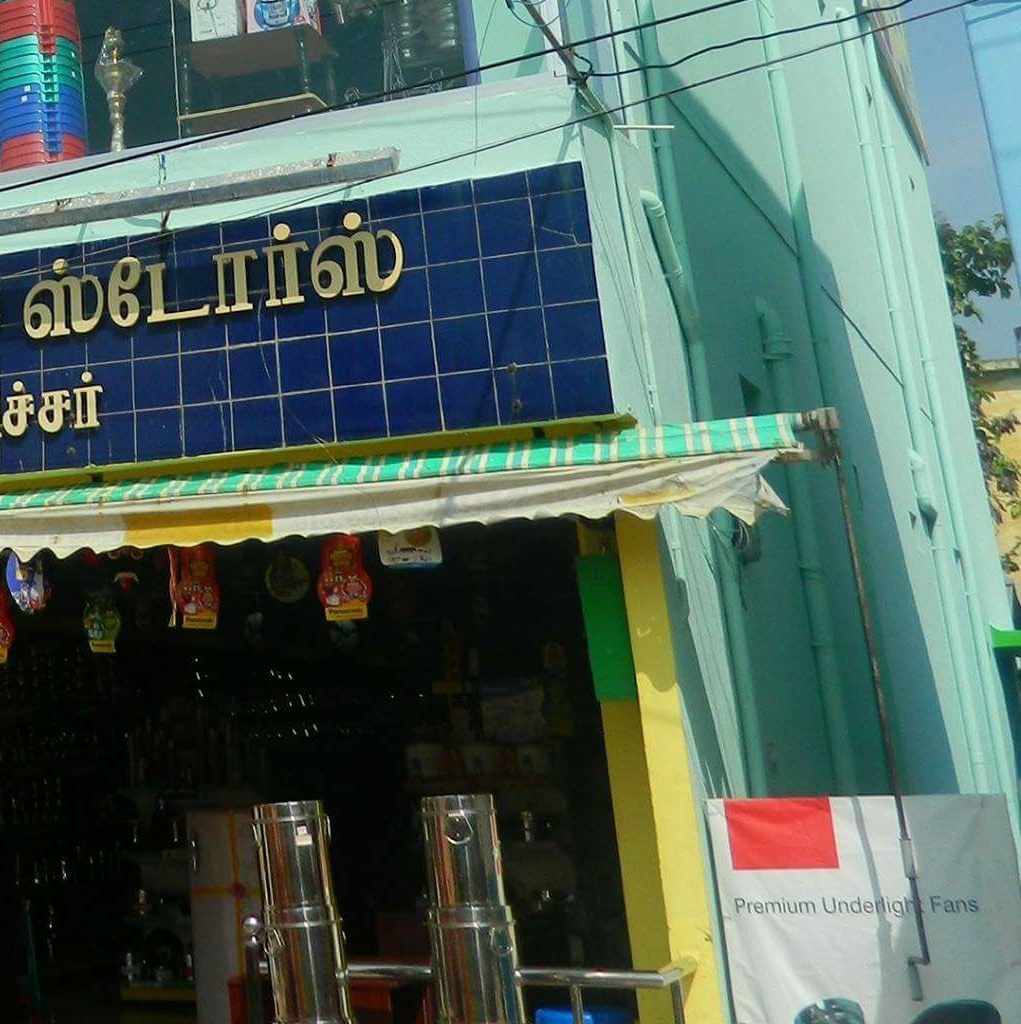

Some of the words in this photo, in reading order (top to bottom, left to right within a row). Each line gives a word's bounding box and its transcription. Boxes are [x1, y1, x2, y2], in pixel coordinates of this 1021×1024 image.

[24, 212, 404, 339] ஸ்டோர்ஸ்
[734, 897, 816, 914] Premium
[822, 895, 924, 917] Underligh
[930, 895, 980, 913] Fans
